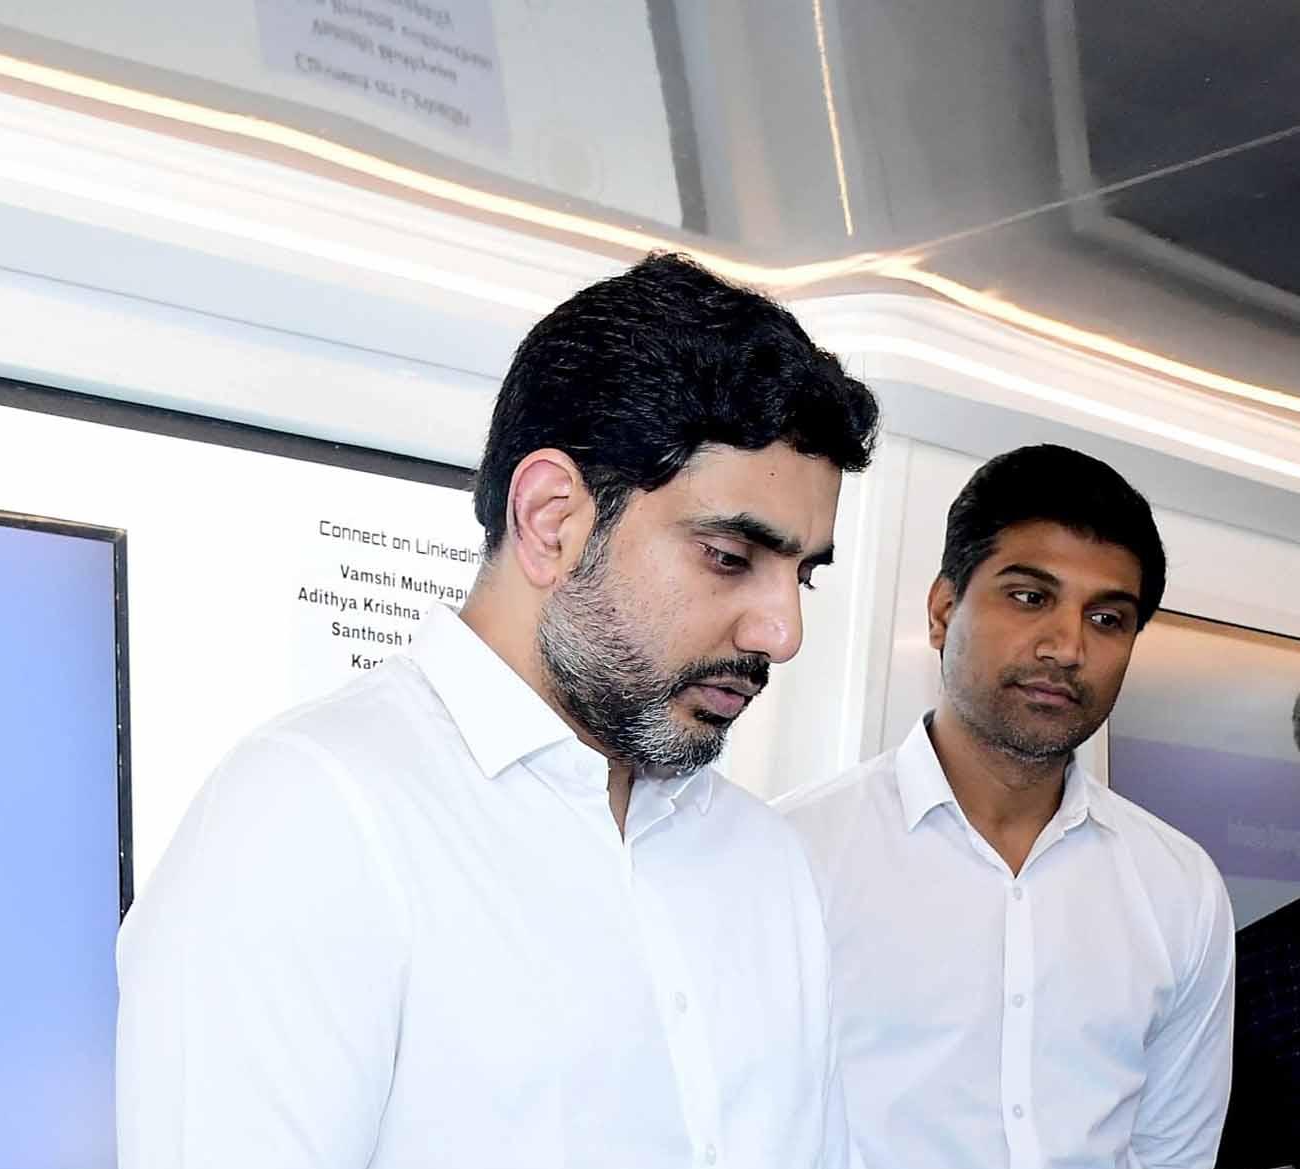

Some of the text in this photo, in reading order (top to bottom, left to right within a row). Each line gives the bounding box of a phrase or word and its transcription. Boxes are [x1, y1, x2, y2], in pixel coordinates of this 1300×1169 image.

[319, 520, 481, 565] Connect on LinkedIn
[340, 564, 396, 588] Vamshi
[298, 587, 421, 621] Adithya Krishna
[331, 621, 403, 647] Santhosh
